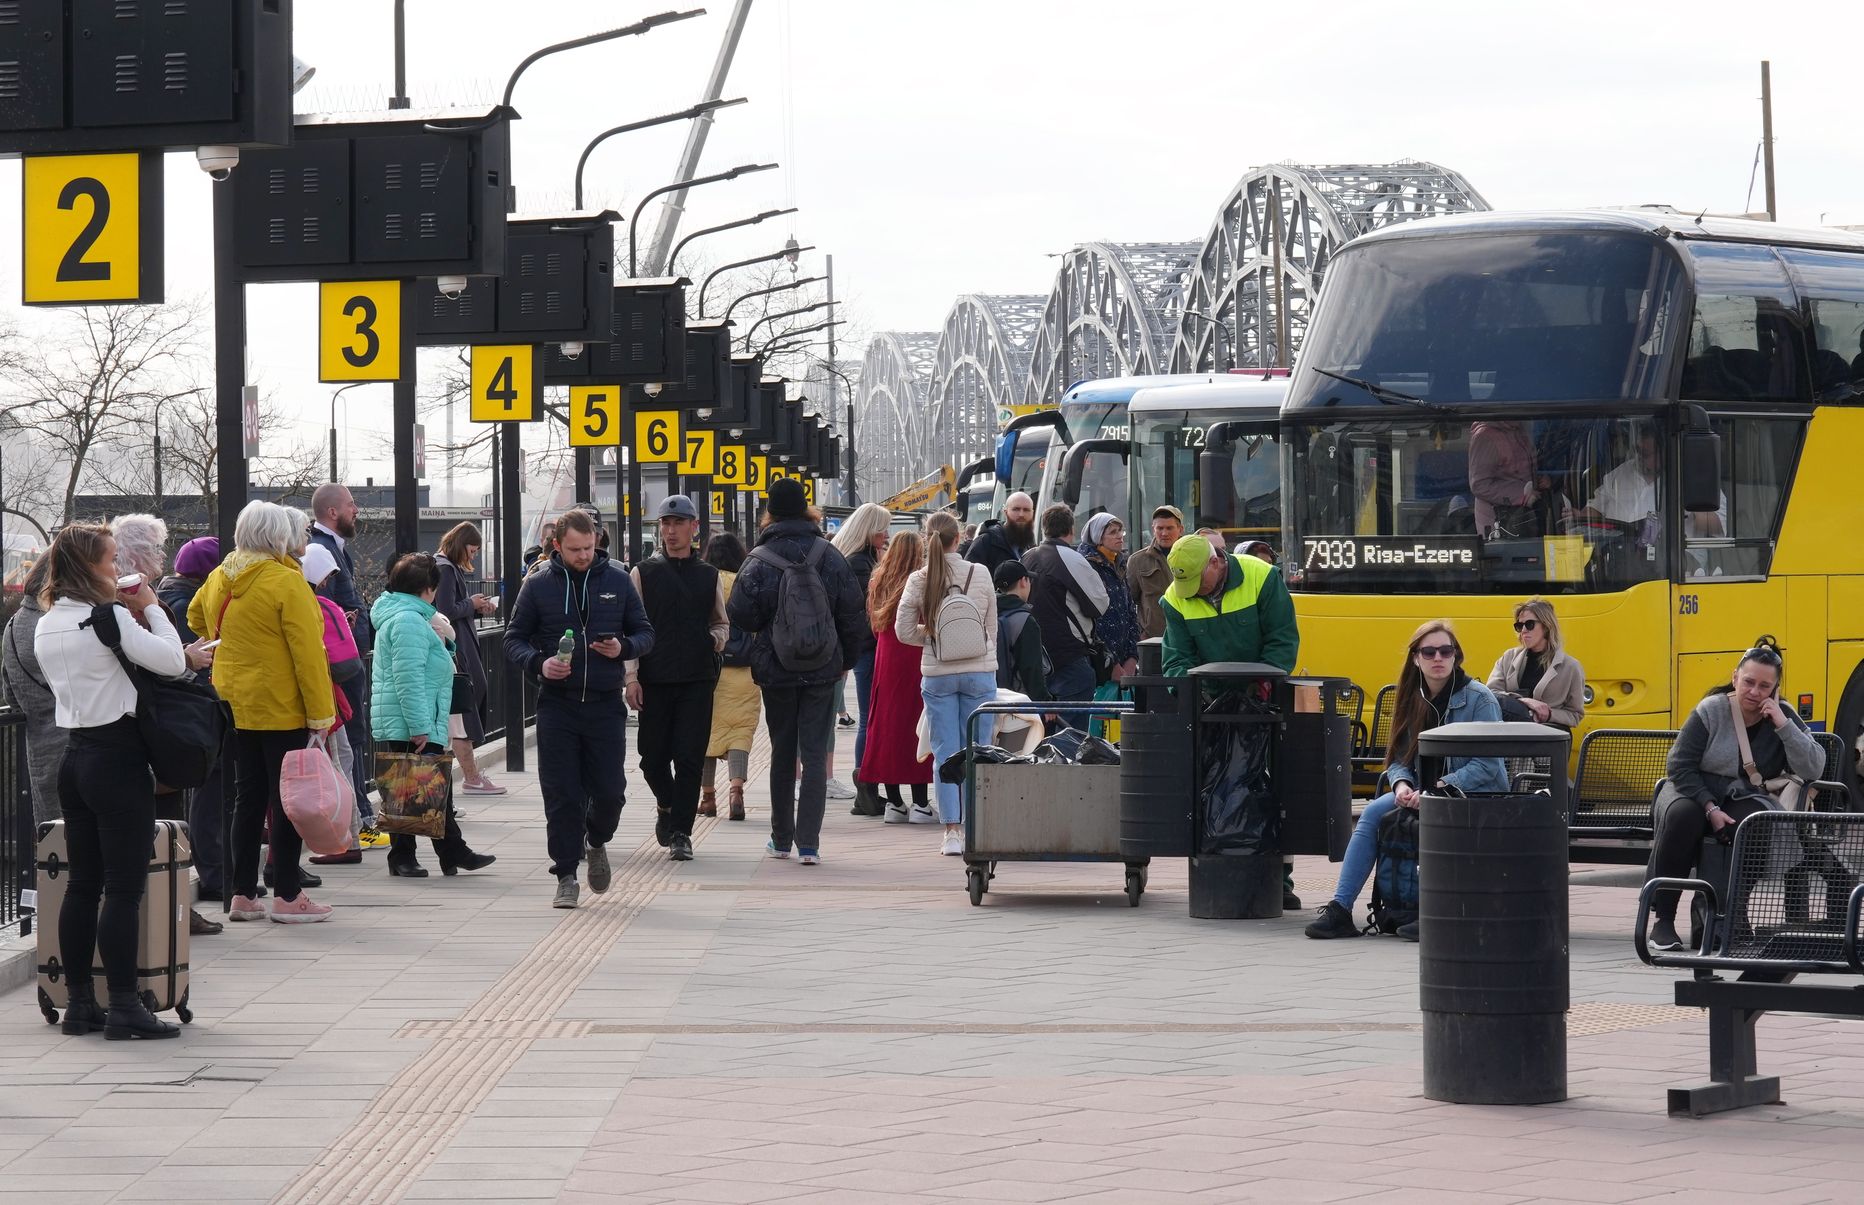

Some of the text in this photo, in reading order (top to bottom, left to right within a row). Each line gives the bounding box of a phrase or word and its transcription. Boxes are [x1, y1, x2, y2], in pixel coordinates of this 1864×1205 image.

[56, 177, 111, 282] 2
[342, 296, 380, 368] 3
[486, 357, 518, 411] 4
[584, 394, 608, 437] 5
[648, 419, 669, 455] 6
[1101, 426, 1129, 440] 7915
[687, 438, 705, 468] 7
[722, 451, 737, 479] 8
[750, 461, 759, 486] 9
[597, 496, 618, 506] NARV
[1304, 540, 1473, 569] 7933 Rīga-Ezere
[1679, 595, 1699, 614] 256
